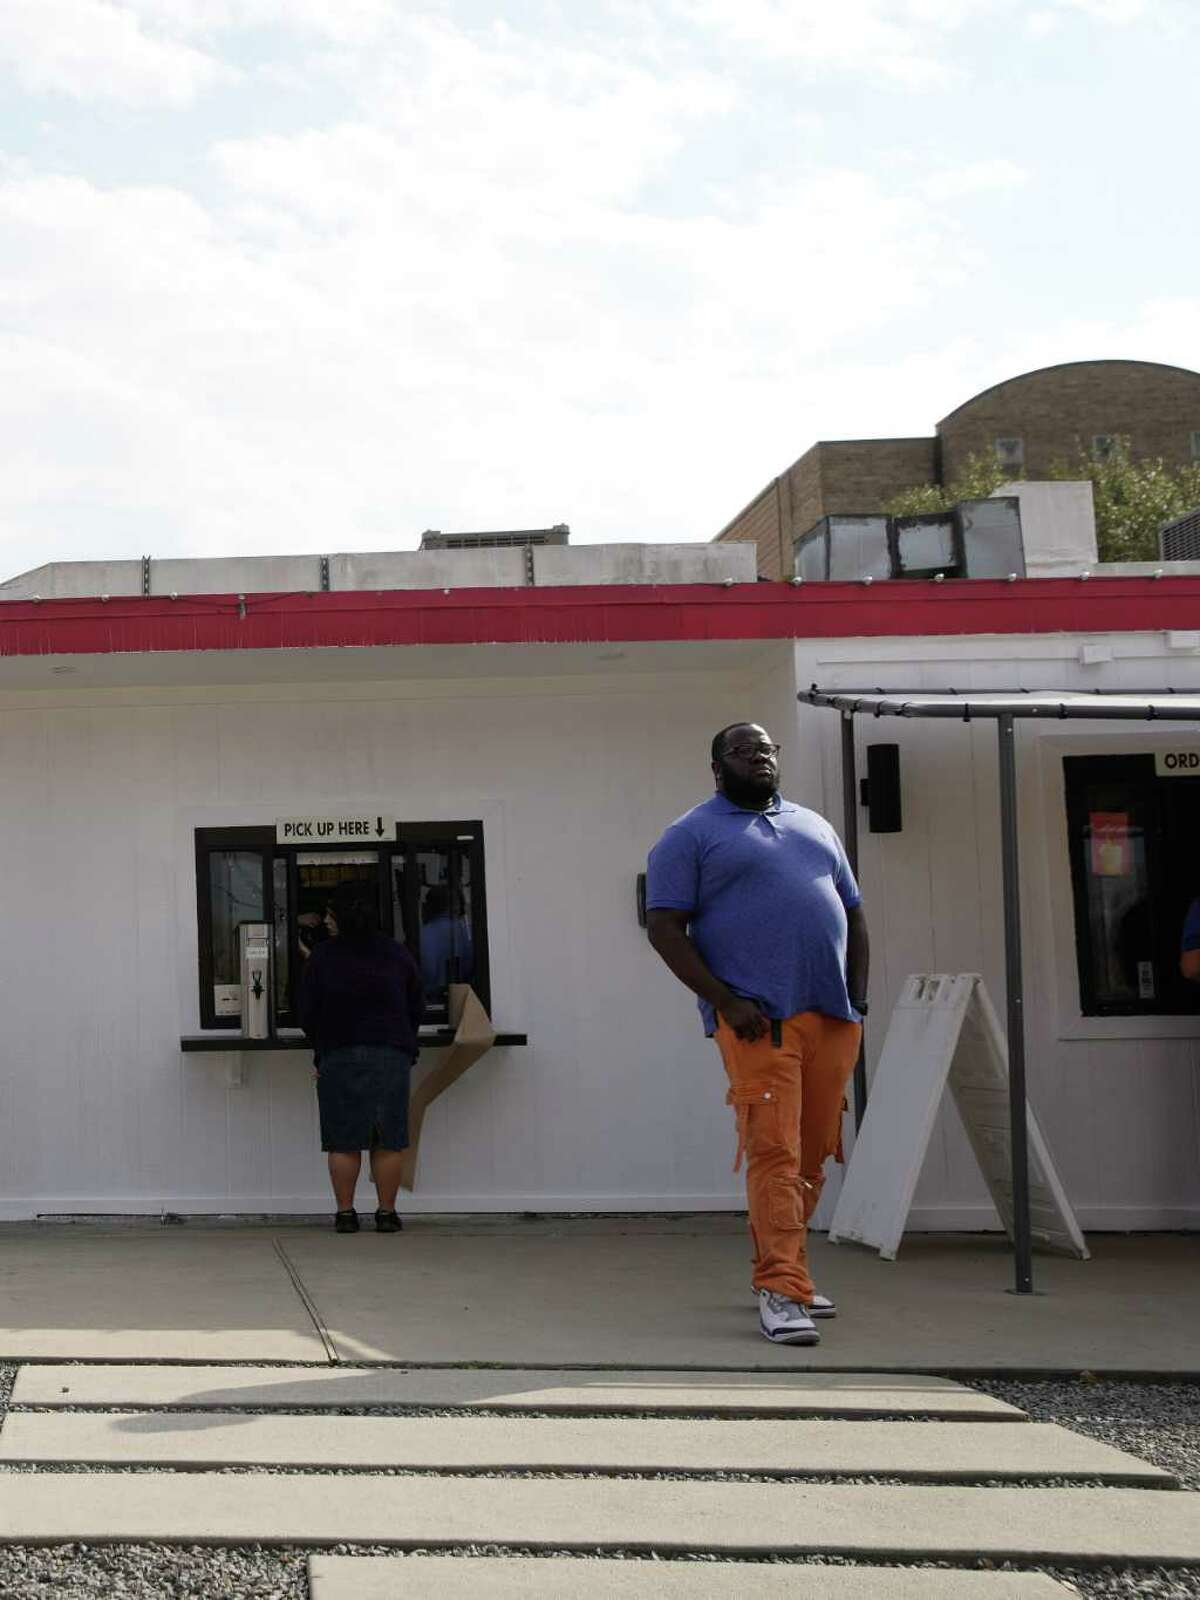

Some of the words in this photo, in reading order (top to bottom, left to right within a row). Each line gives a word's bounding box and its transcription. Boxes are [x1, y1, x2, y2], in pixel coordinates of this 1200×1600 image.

[1164, 753, 1200, 769] ORD
[284, 822, 313, 837] PICK
[317, 822, 335, 836] UP
[338, 820, 370, 835] HERE
